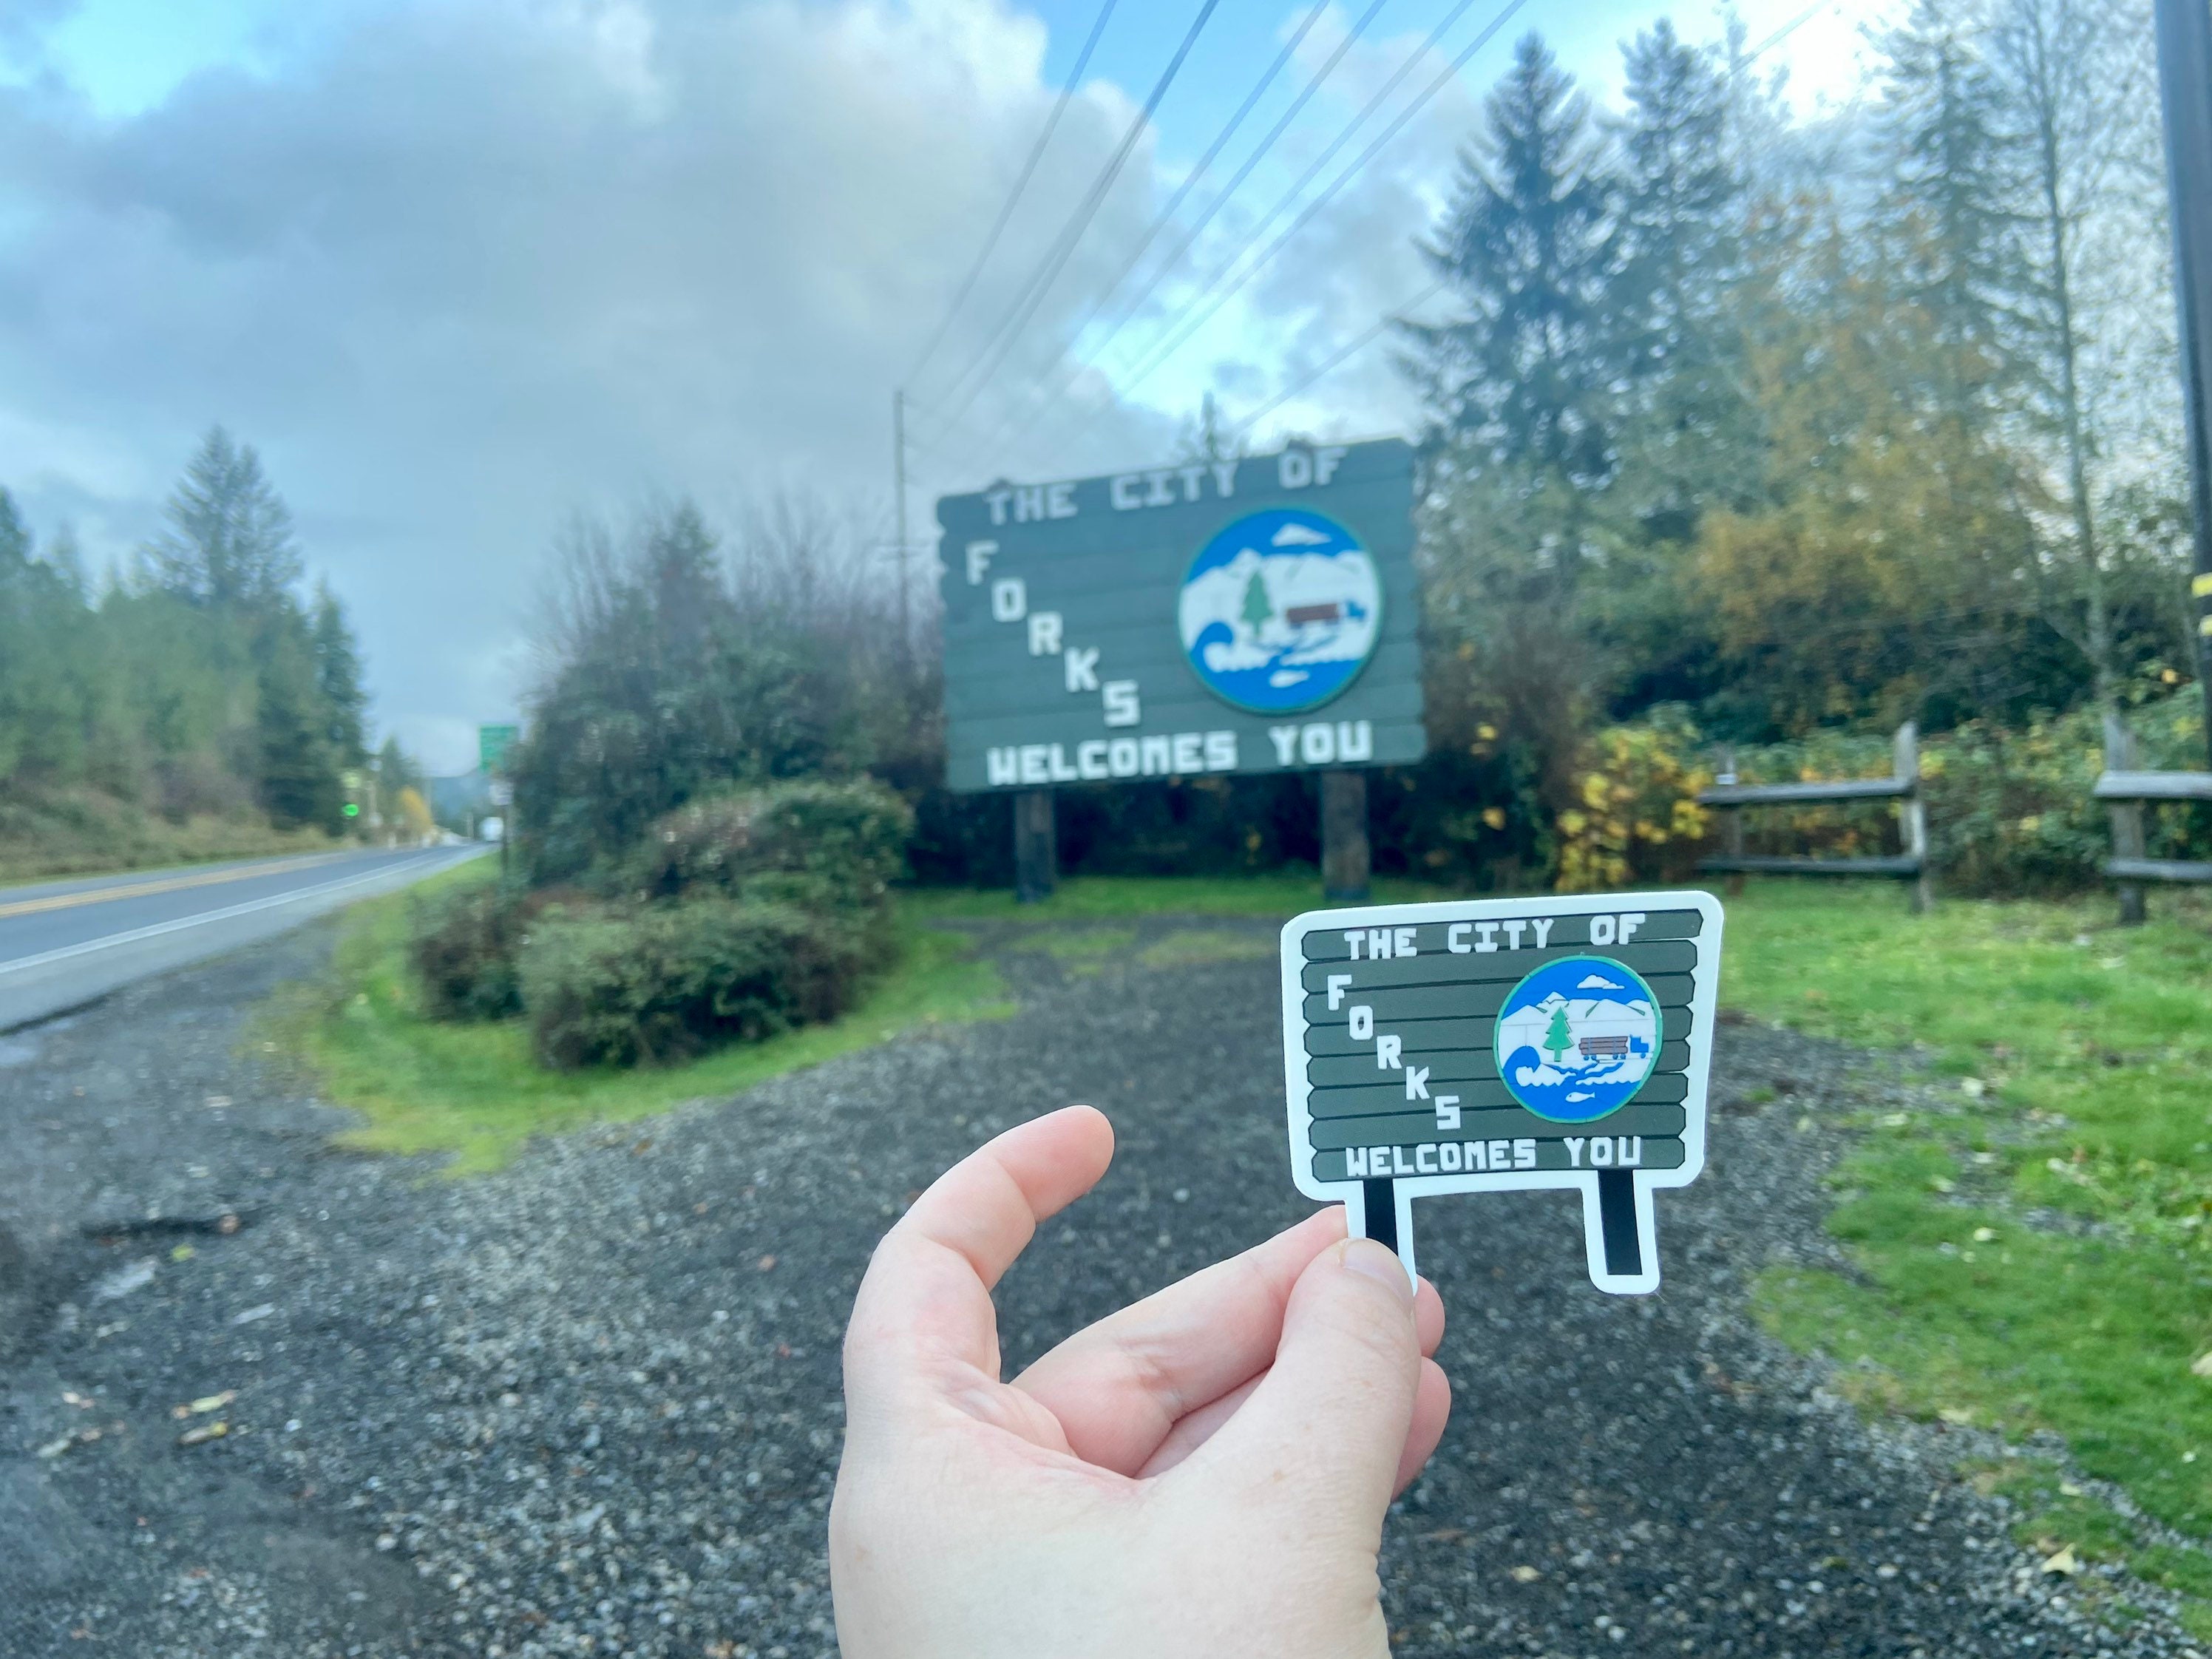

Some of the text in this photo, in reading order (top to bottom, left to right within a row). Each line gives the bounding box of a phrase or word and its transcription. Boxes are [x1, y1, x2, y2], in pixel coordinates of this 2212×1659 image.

[986, 447, 1346, 524] THE CITY OF
[966, 540, 1140, 727] FORKS
[986, 720, 1373, 785] WELCOMES YOU
[1344, 913, 1646, 960] THE CITY OF
[1327, 974, 1461, 1130] FORKS
[1346, 1136, 1641, 1176] WELCOMES YOU
